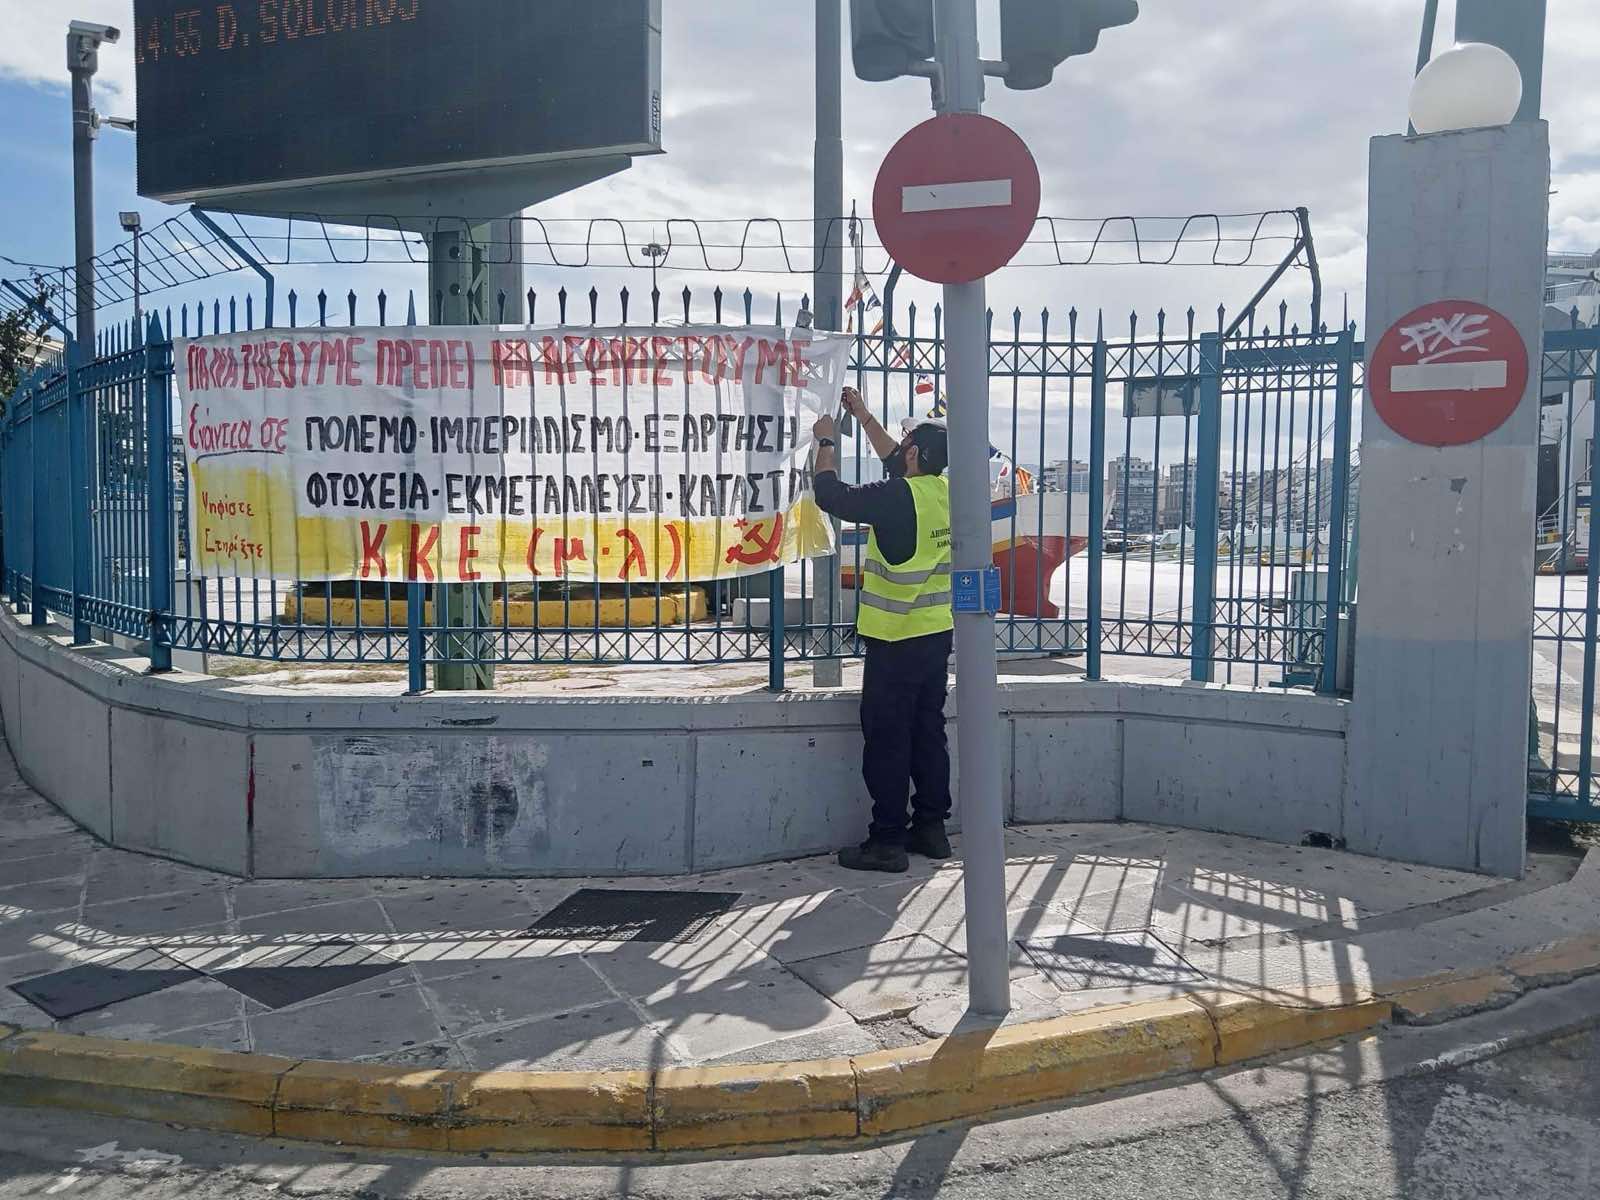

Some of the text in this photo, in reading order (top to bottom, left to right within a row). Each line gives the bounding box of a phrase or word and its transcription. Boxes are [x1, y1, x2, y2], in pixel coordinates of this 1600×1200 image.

[376, 339, 474, 389] ΠΡΕΠΕΙ
[644, 414, 797, 453] ΕΞΑΡΤΗΣΗ
[359, 520, 482, 582] ΚΚΕ
